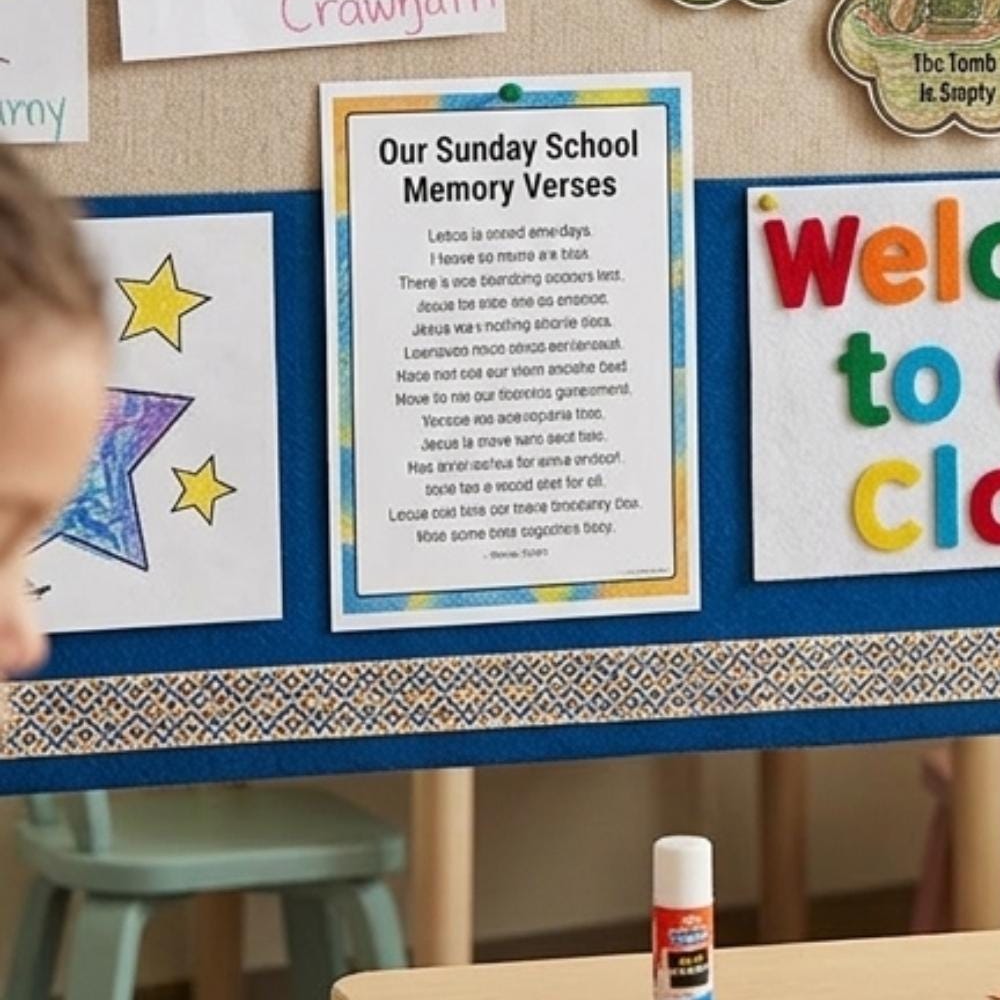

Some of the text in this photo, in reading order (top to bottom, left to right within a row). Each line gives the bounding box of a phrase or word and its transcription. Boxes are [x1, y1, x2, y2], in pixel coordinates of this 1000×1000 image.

[379, 129, 638, 167] Our Sunday School
[404, 172, 617, 207] Memory Verses
[837, 331, 962, 427] to
